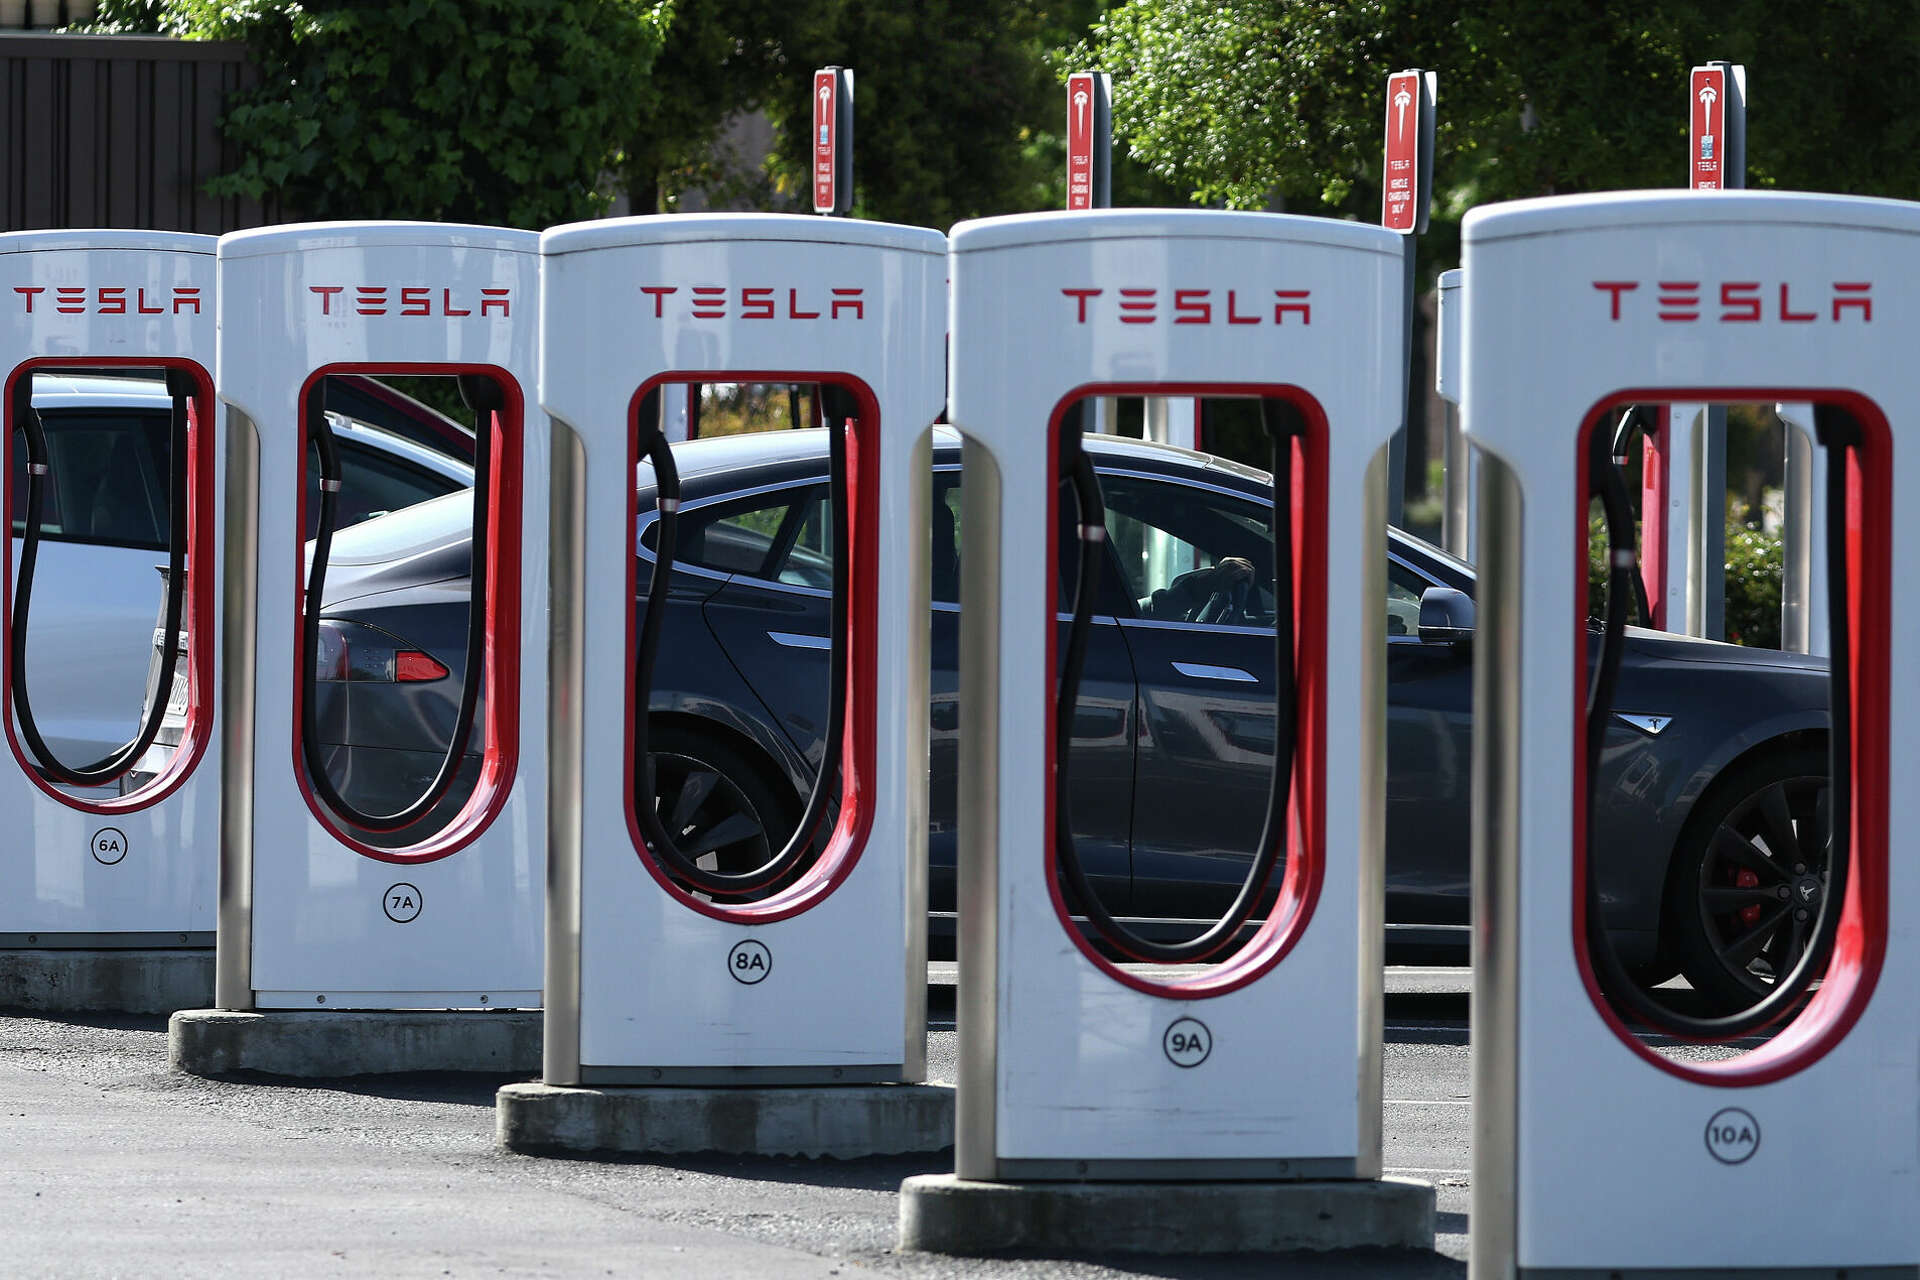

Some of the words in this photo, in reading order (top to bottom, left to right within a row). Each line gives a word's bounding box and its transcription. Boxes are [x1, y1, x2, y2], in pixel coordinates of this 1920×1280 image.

[1390, 159, 1411, 170] TESLA
[1697, 161, 1718, 171] TESLA
[14, 287, 201, 315] TESLA
[310, 286, 510, 317] TESLA
[640, 286, 865, 320] TESLA
[1061, 288, 1311, 325] TESLA
[1592, 281, 1873, 323] TESLA
[98, 839, 120, 853] 6A
[391, 895, 415, 909] 7A
[735, 952, 765, 971] 8A
[1171, 1032, 1204, 1053] 9A
[1711, 1126, 1754, 1145] 10A
